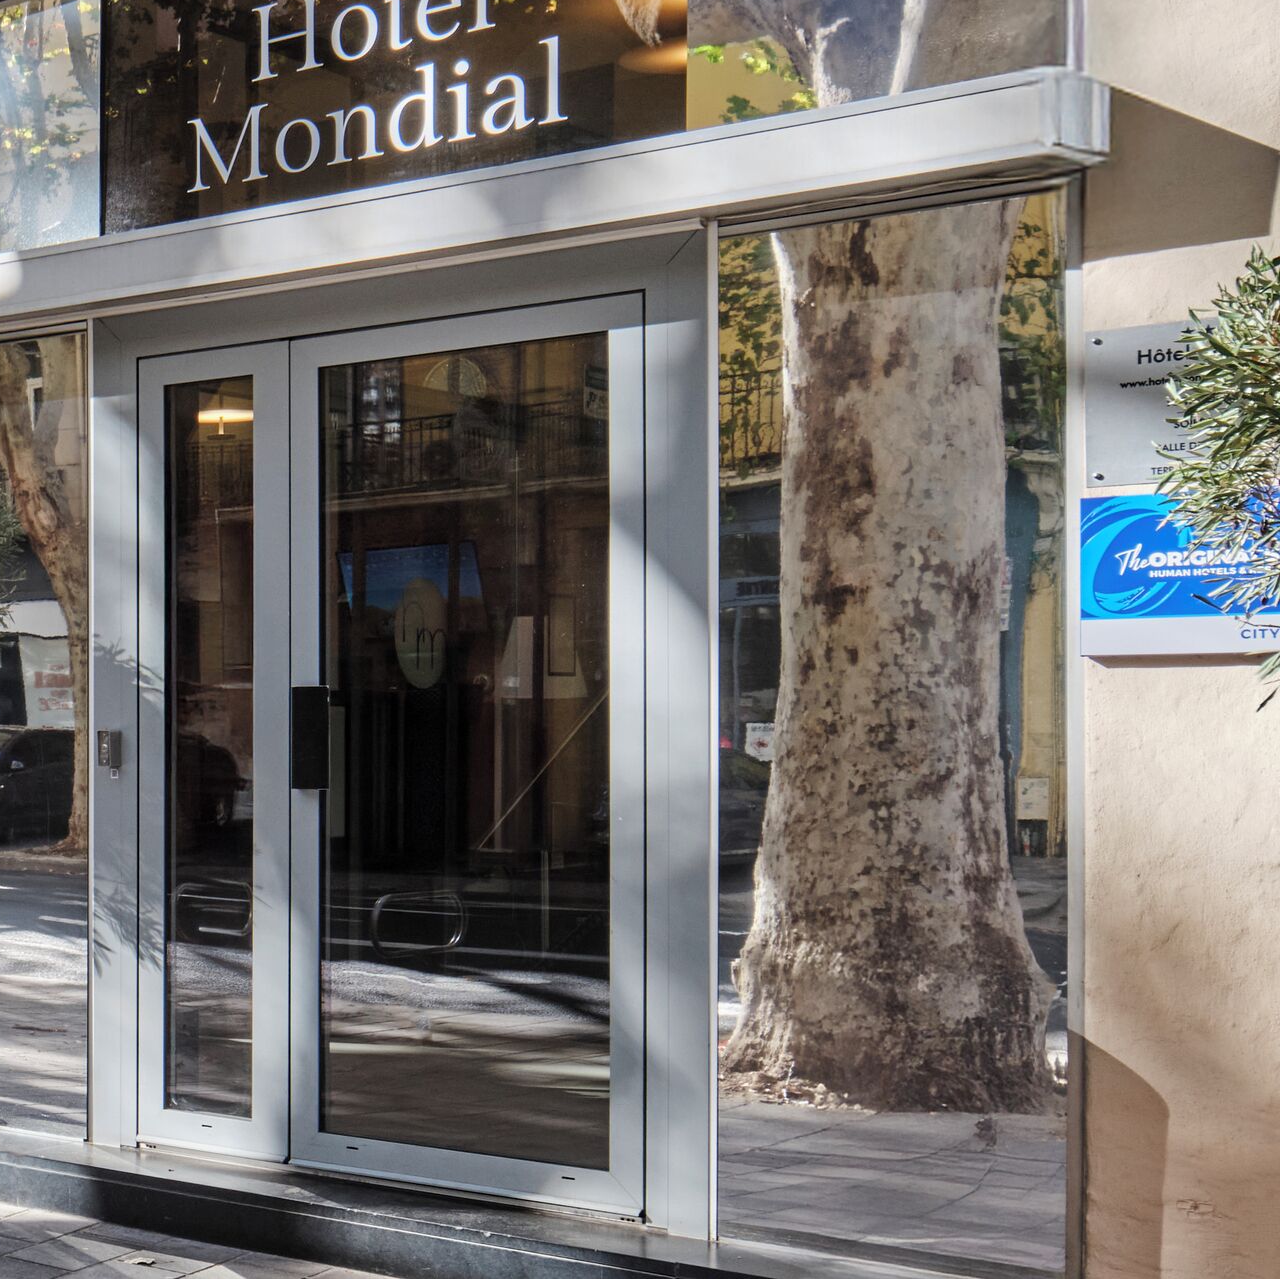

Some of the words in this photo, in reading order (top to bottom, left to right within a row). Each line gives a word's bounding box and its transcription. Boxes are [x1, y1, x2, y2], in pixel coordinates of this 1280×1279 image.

[185, 35, 569, 194] Mondial
[1157, 442, 1186, 452] ALLE
[1114, 542, 1150, 577] The
[1149, 569, 1191, 578] HUMAN
[1193, 567, 1237, 577] HOTELS
[1240, 628, 1280, 640] CITY
